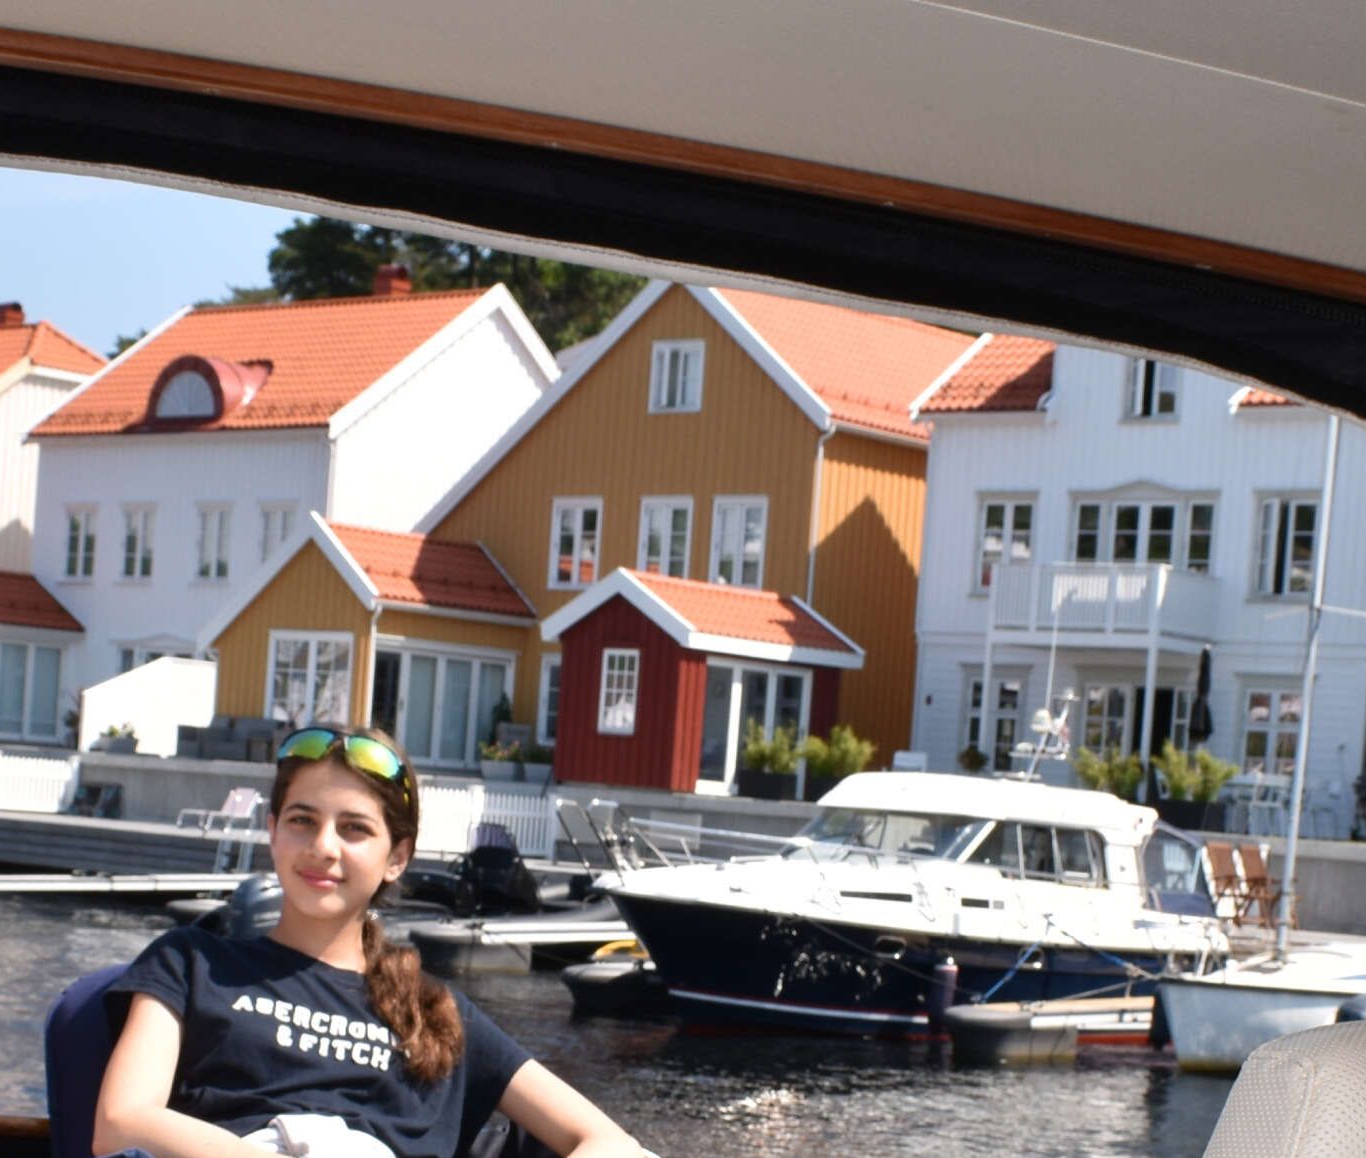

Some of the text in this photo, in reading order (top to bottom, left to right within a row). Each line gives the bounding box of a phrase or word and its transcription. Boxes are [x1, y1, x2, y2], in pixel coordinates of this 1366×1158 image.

[232, 995, 398, 1047] ABERCROM
[276, 1025, 392, 1071] & FITCH
